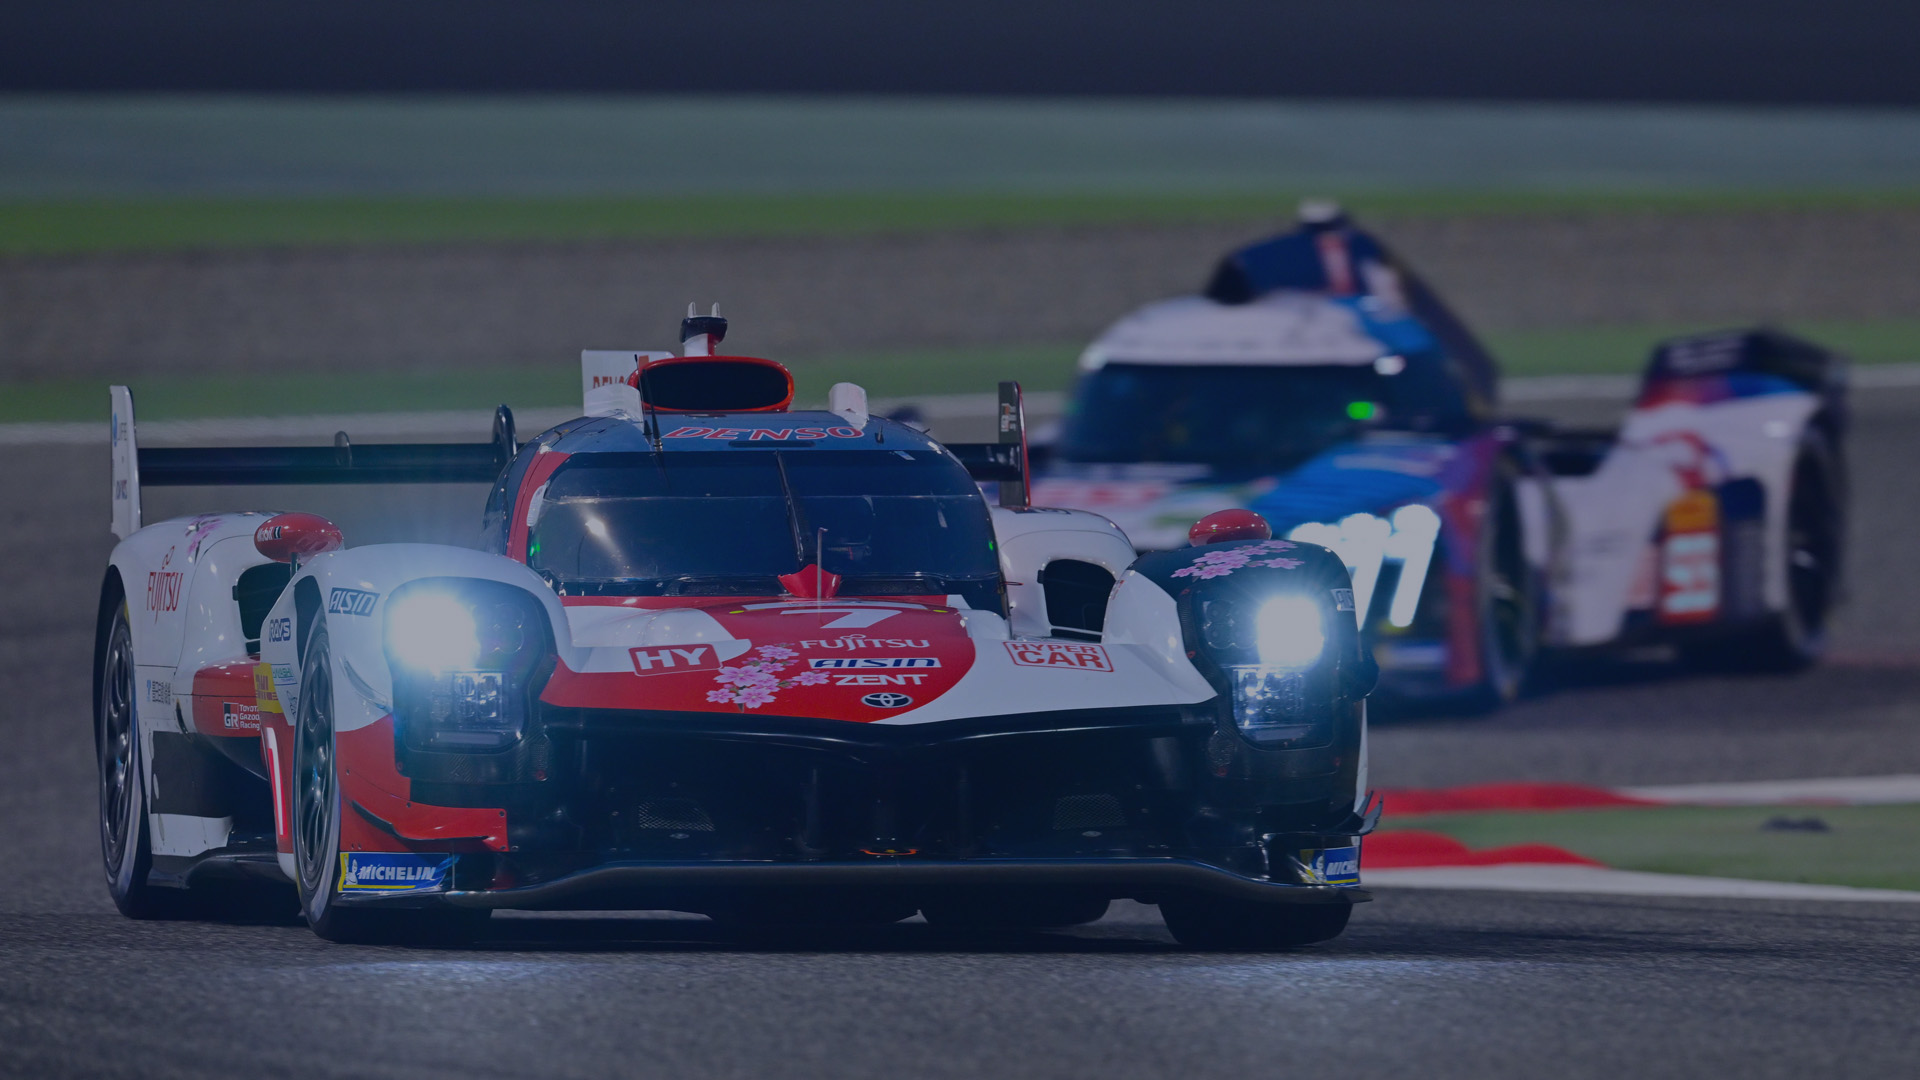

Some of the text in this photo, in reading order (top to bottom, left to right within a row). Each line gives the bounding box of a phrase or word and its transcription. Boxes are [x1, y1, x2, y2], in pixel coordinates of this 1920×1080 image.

[661, 426, 865, 441] DENSO
[146, 545, 184, 625] FUJITSU
[329, 589, 378, 615] AISIN
[780, 607, 903, 629] 7
[799, 633, 931, 651] FUJITSU
[1010, 643, 1098, 654] HYPER
[635, 647, 708, 671] HY
[813, 657, 935, 669] AISIN
[1017, 650, 1105, 669] CAR
[832, 674, 929, 686] ZENT
[240, 704, 259, 712] TOYOT
[224, 712, 239, 728] GR
[357, 864, 437, 881] MICHELIN
